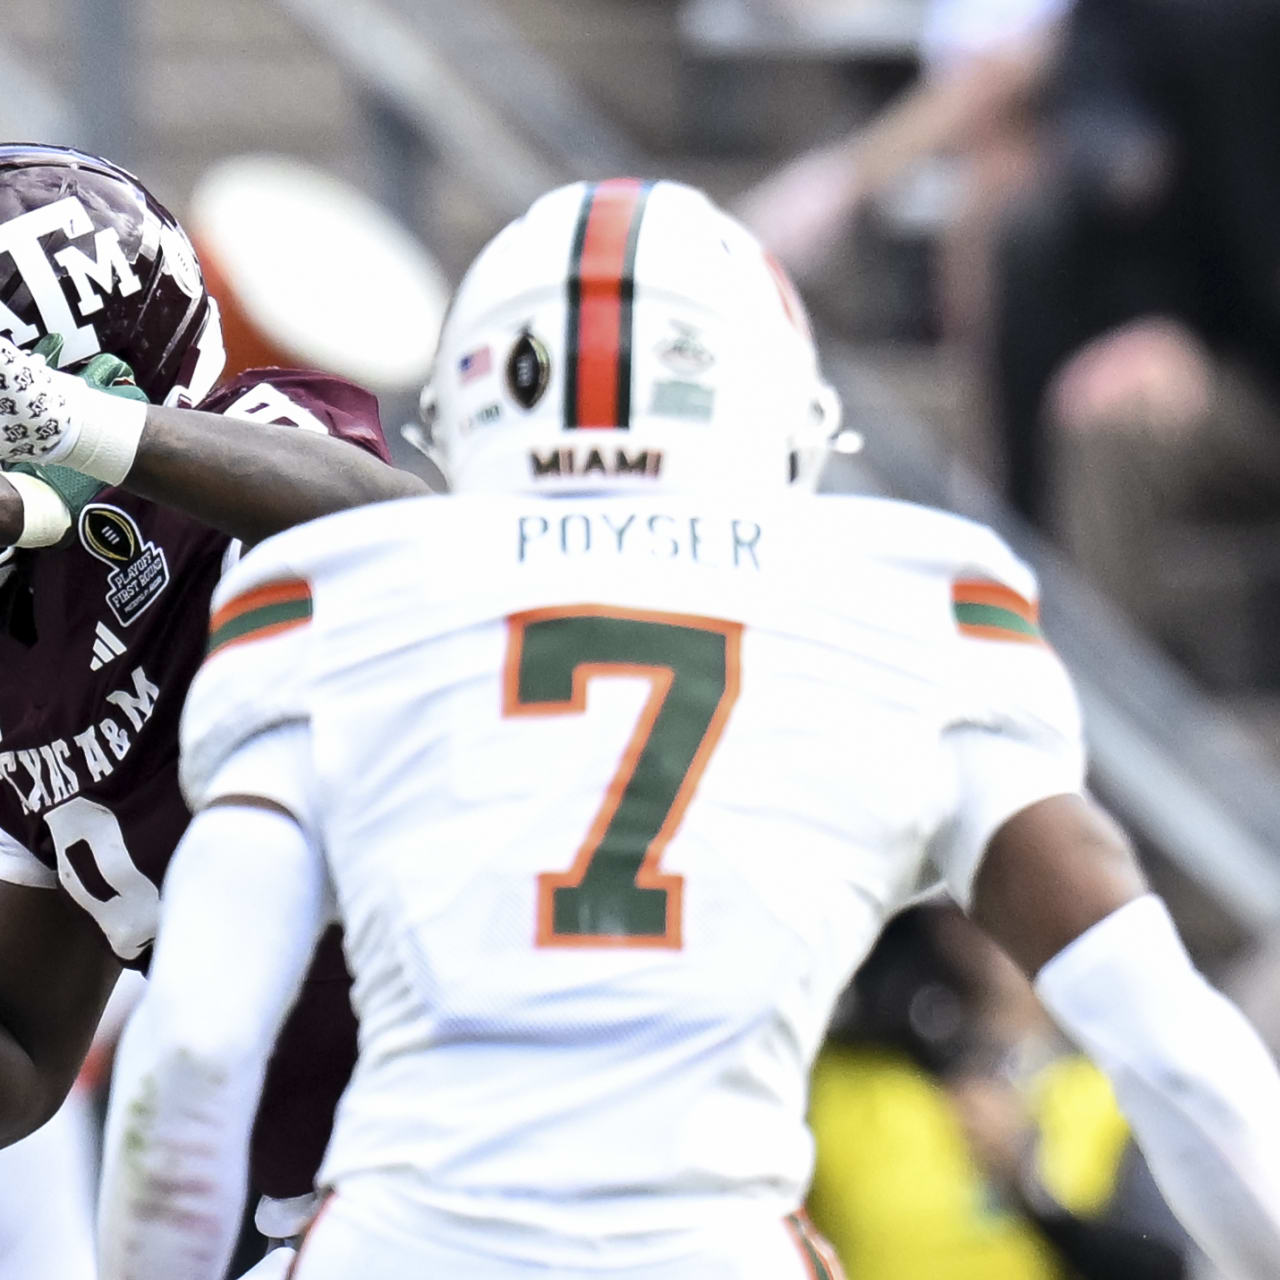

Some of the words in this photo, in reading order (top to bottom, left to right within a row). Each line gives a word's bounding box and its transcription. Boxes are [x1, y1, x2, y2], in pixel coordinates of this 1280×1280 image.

[531, 449, 661, 477] MIAMI
[517, 514, 761, 570] POYSER
[114, 551, 153, 589] PLAYOFF
[111, 582, 140, 608] FIRST
[73, 665, 160, 784] A&M
[502, 603, 747, 951] 7
